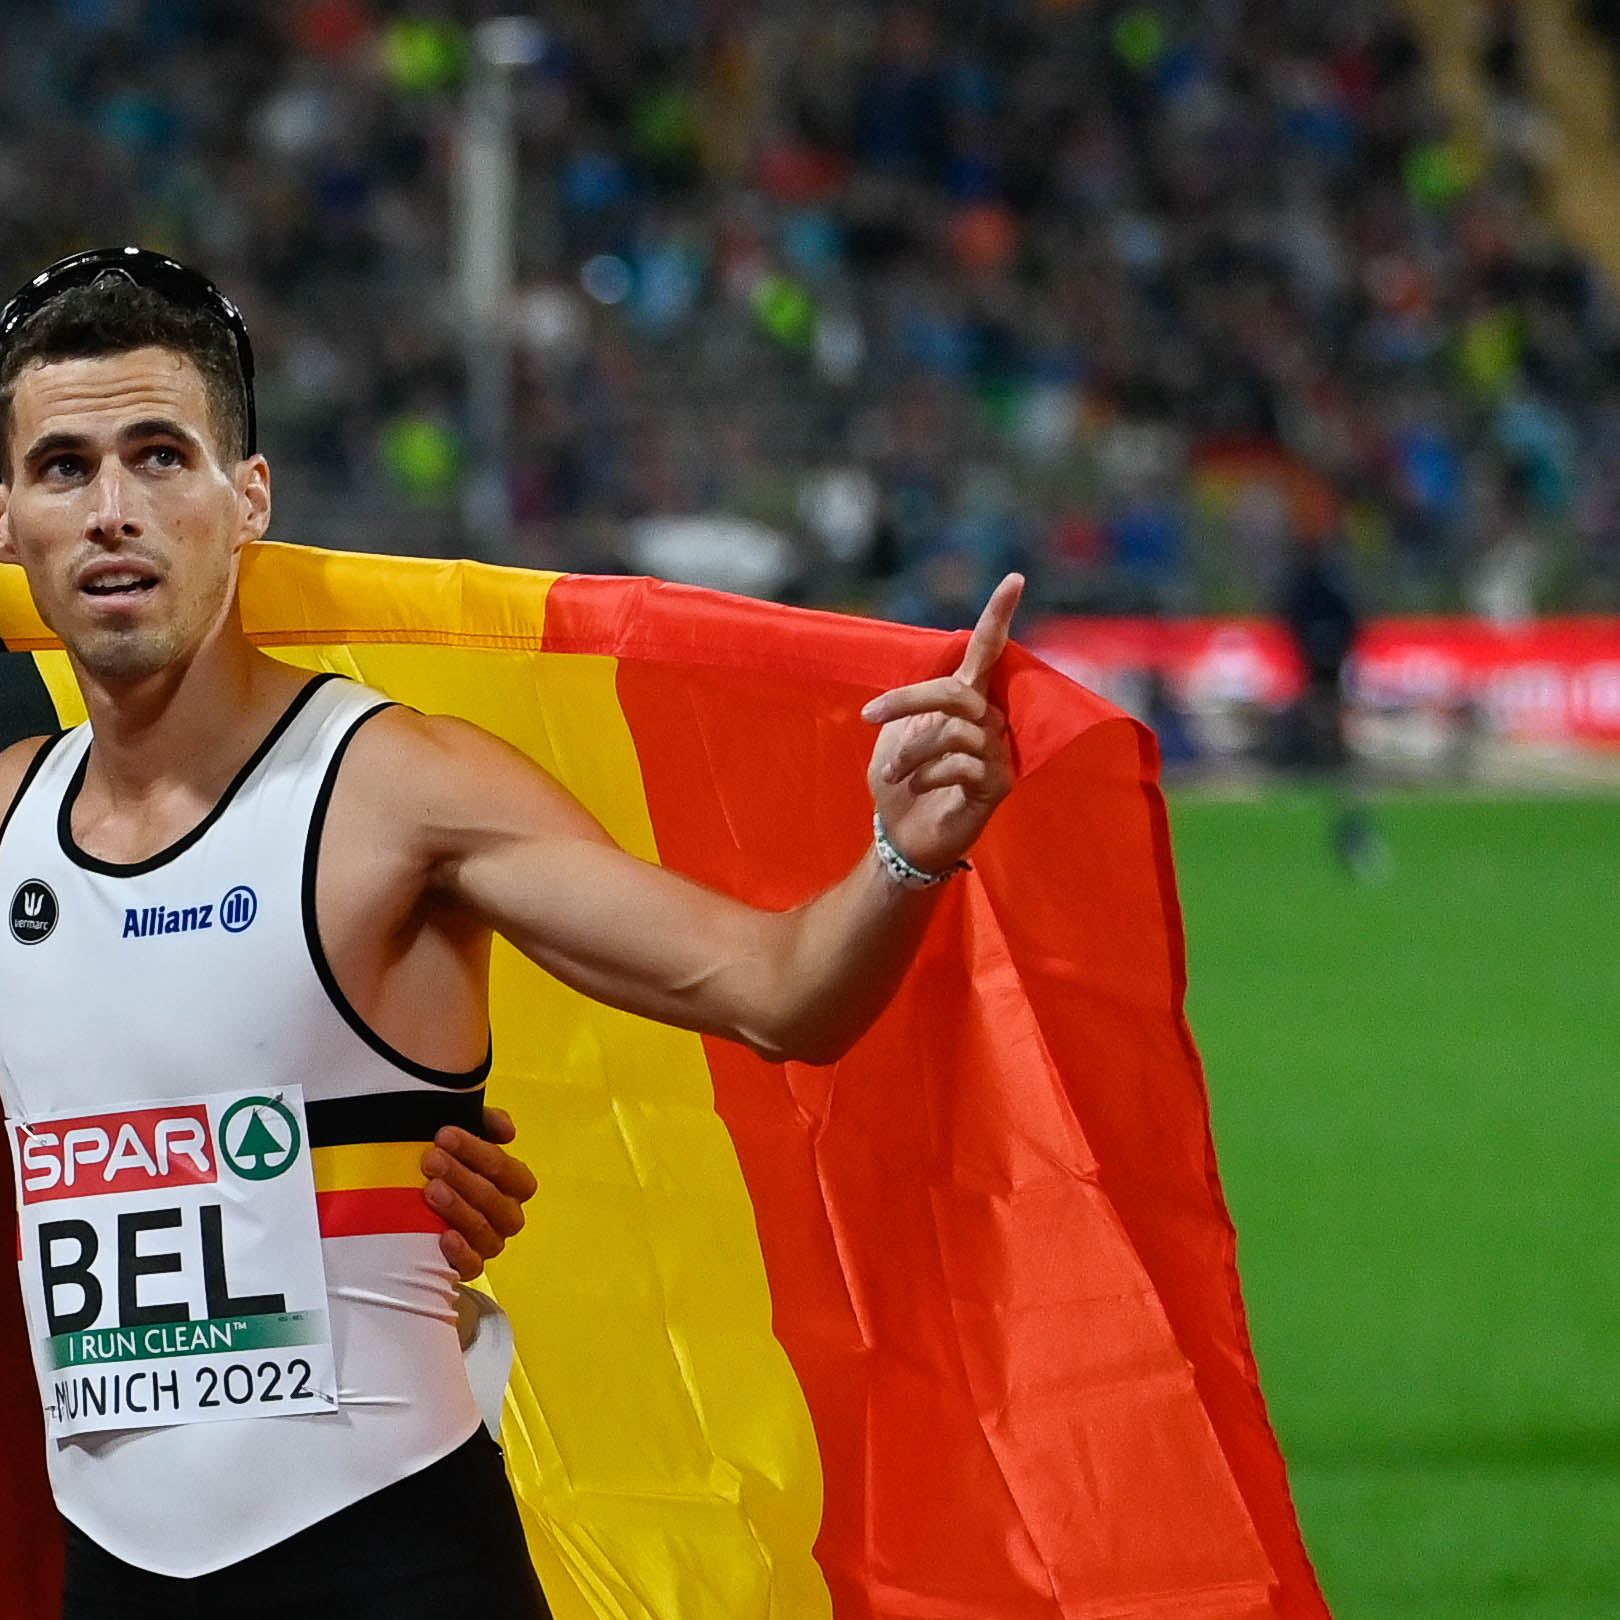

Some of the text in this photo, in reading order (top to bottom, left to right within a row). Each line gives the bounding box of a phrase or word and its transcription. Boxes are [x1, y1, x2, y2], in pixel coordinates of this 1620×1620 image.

[123, 903, 213, 938] Allianz
[23, 1118, 212, 1192] SPAR
[38, 1204, 286, 1336] BEL
[69, 1337, 75, 1361] I
[82, 1331, 136, 1360] RUN
[55, 1359, 313, 1423] MUNICH 2022
